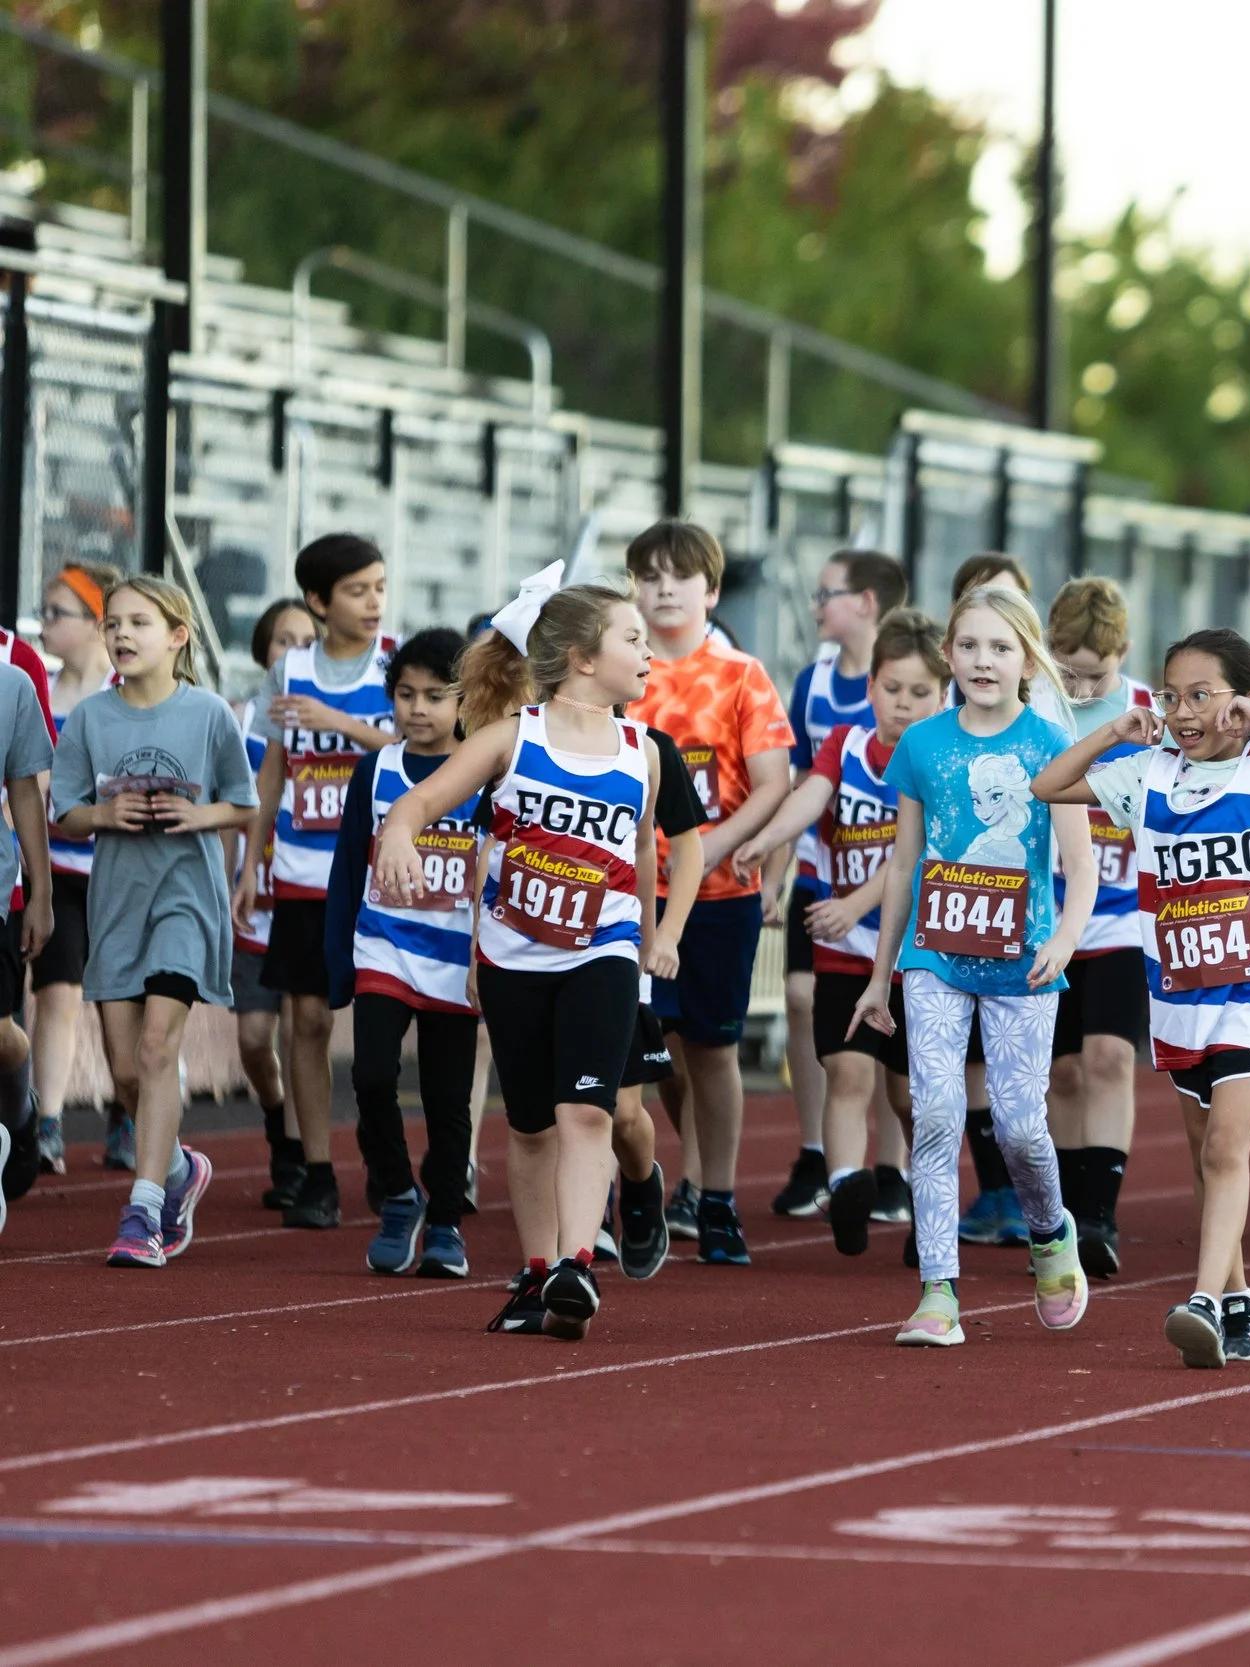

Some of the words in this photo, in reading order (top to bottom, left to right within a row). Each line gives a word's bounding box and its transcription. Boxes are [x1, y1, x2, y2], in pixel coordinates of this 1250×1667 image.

[506, 845, 577, 877] Athletic
[577, 871, 601, 881] NET
[924, 863, 996, 886] Athletic
[998, 878, 1019, 888] NET
[508, 871, 588, 930] 1911
[925, 890, 1016, 937] 1844
[1157, 899, 1220, 921] Athletic
[1222, 899, 1246, 910] NET
[1165, 920, 1250, 970] 1854
[580, 1075, 599, 1085] NIKE
